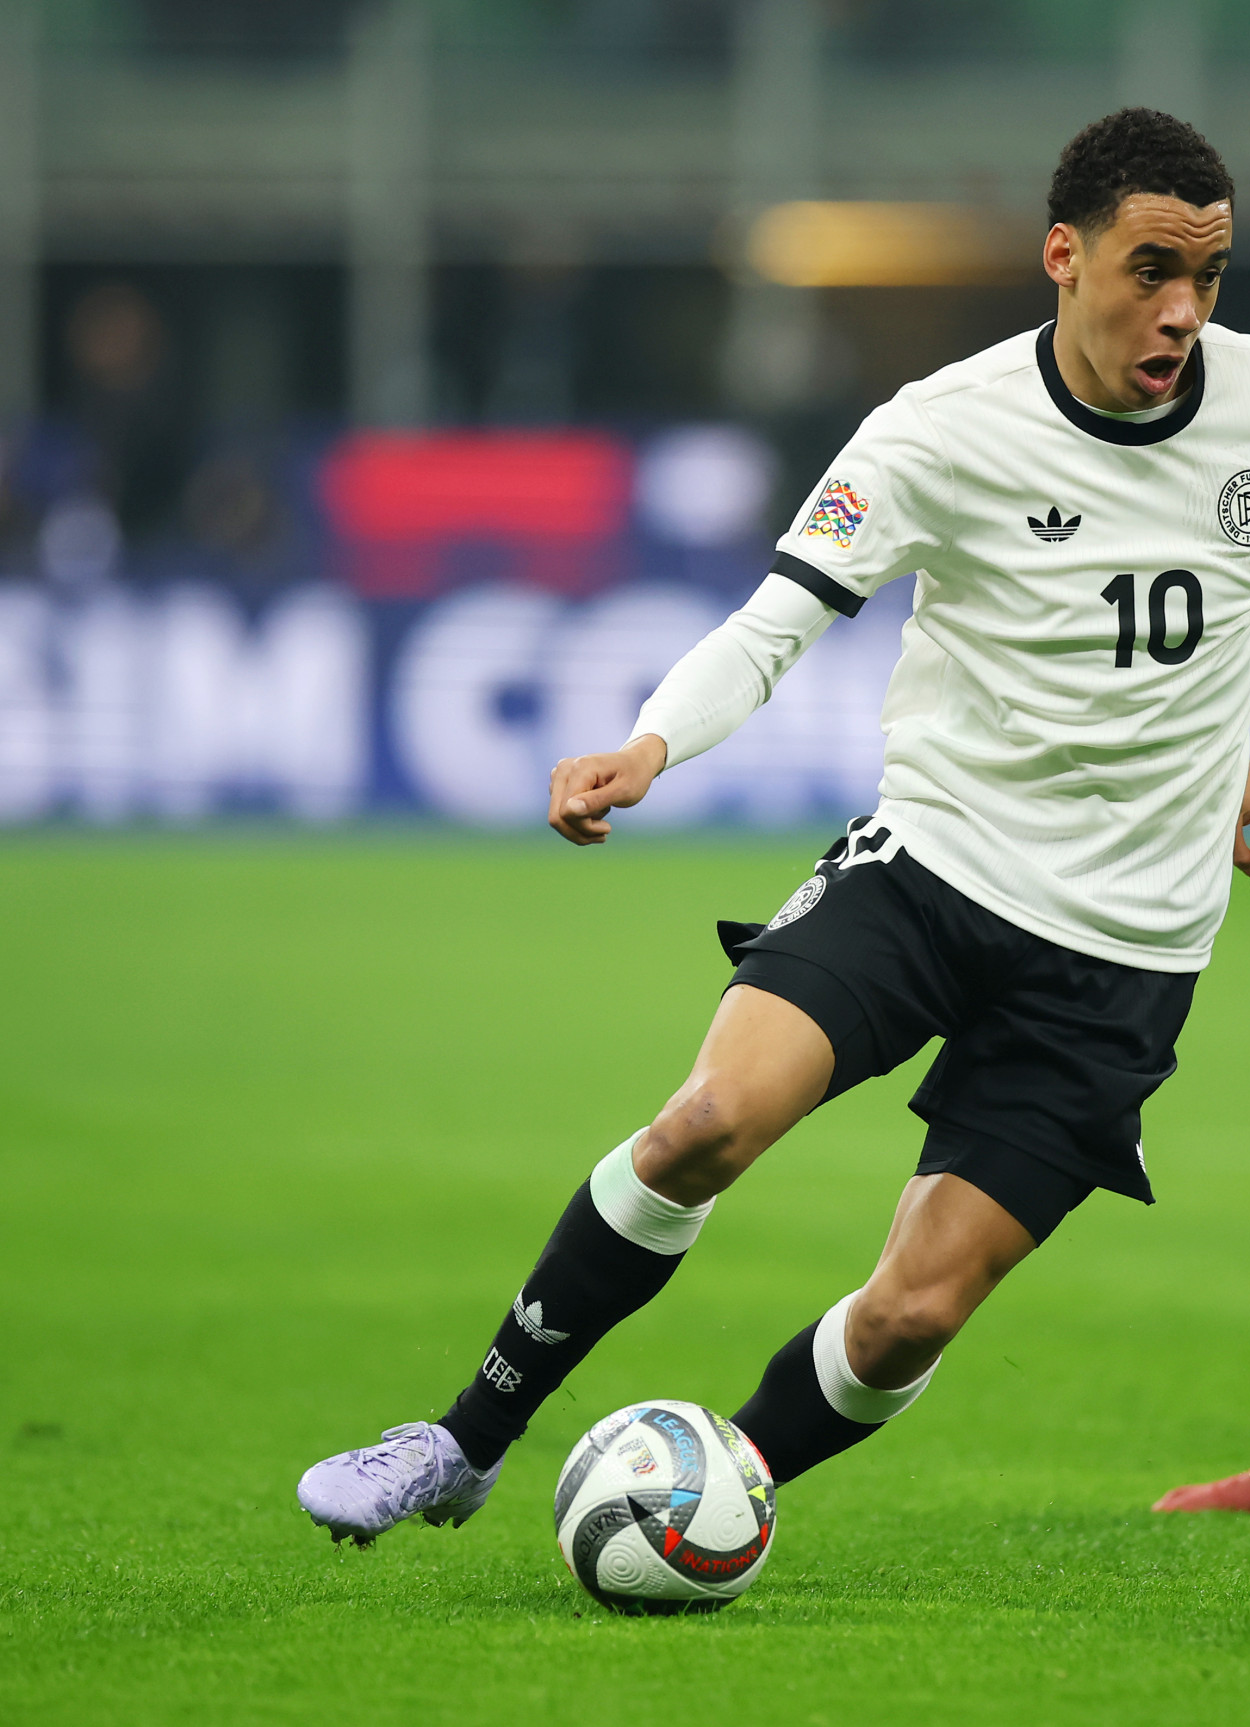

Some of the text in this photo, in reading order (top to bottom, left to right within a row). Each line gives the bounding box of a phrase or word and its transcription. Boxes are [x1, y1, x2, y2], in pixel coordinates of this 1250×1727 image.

[1221, 480, 1241, 539] DEUTSCHER
[1100, 569, 1204, 668] 10
[652, 1413, 698, 1473] LEAGUE
[681, 1545, 759, 1574] NATIONS
